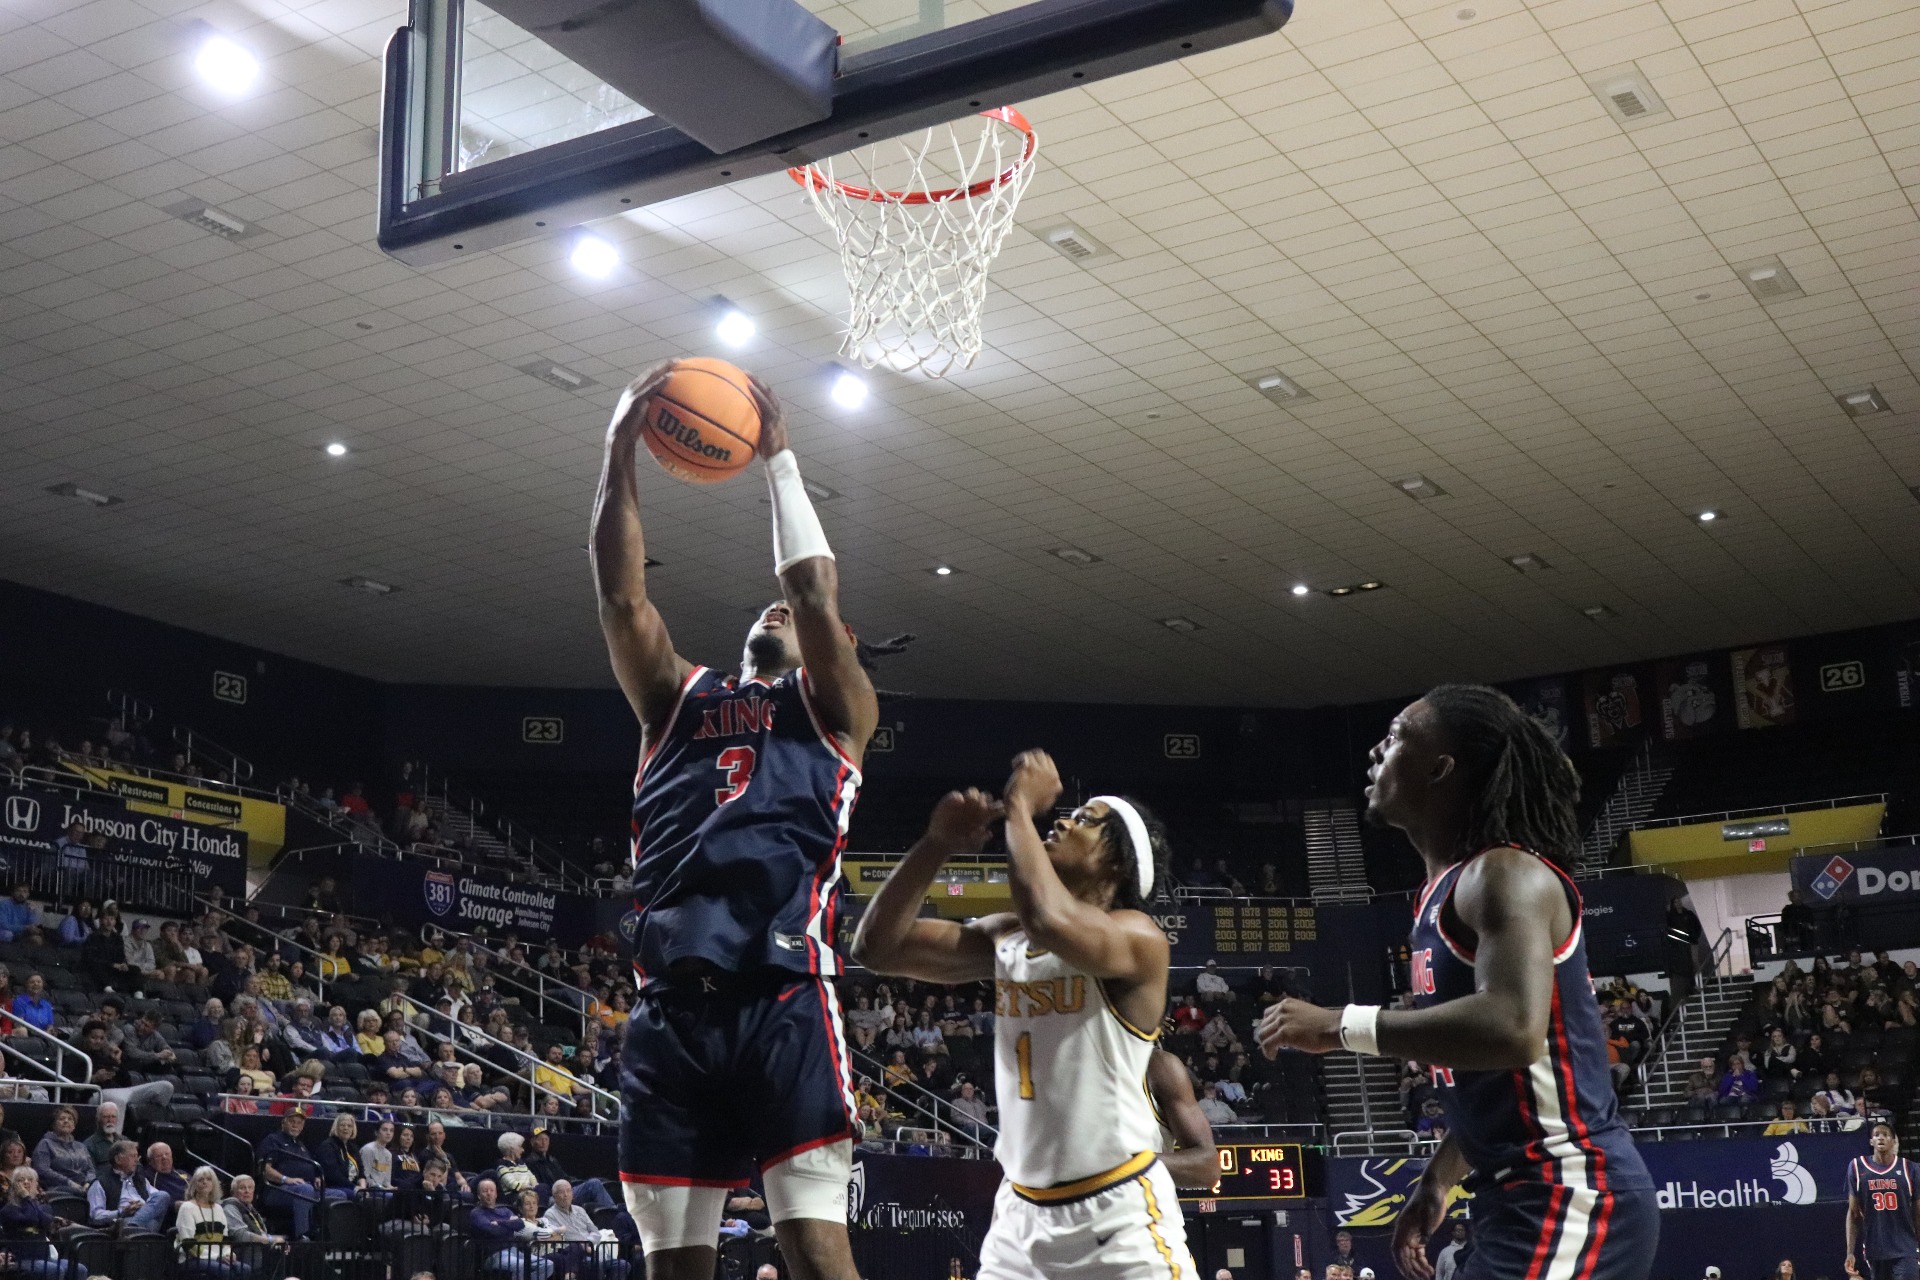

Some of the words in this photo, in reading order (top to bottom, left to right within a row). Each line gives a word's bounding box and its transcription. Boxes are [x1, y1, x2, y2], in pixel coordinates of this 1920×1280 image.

[657, 407, 732, 462] Wilson
[218, 675, 242, 699] 23
[1826, 666, 1859, 687] 26
[527, 721, 559, 740] 23
[1169, 738, 1195, 756] 25
[715, 744, 757, 807] 3
[121, 783, 164, 801] Restrooms
[186, 796, 233, 815] Concessions
[61, 804, 136, 842] Johnson
[140, 819, 180, 855] City
[181, 825, 241, 859] Honda
[429, 882, 451, 904] 381
[458, 878, 501, 900] Climate
[502, 886, 556, 911] Controlled
[458, 897, 514, 929] Storage
[518, 918, 540, 929] Johnson
[540, 920, 551, 932] City
[791, 940, 804, 948] XXL
[700, 976, 717, 993] K
[994, 975, 1086, 1018] ETSU
[1016, 1031, 1035, 1100] 1
[1251, 1148, 1285, 1162] KING
[1270, 1168, 1294, 1190] 33
[1868, 1178, 1898, 1191] KING
[1655, 1178, 1770, 1209] dHealth
[1872, 1191, 1898, 1211] 30
[867, 1203, 884, 1229] of
[1199, 1199, 1217, 1213] EXIT
